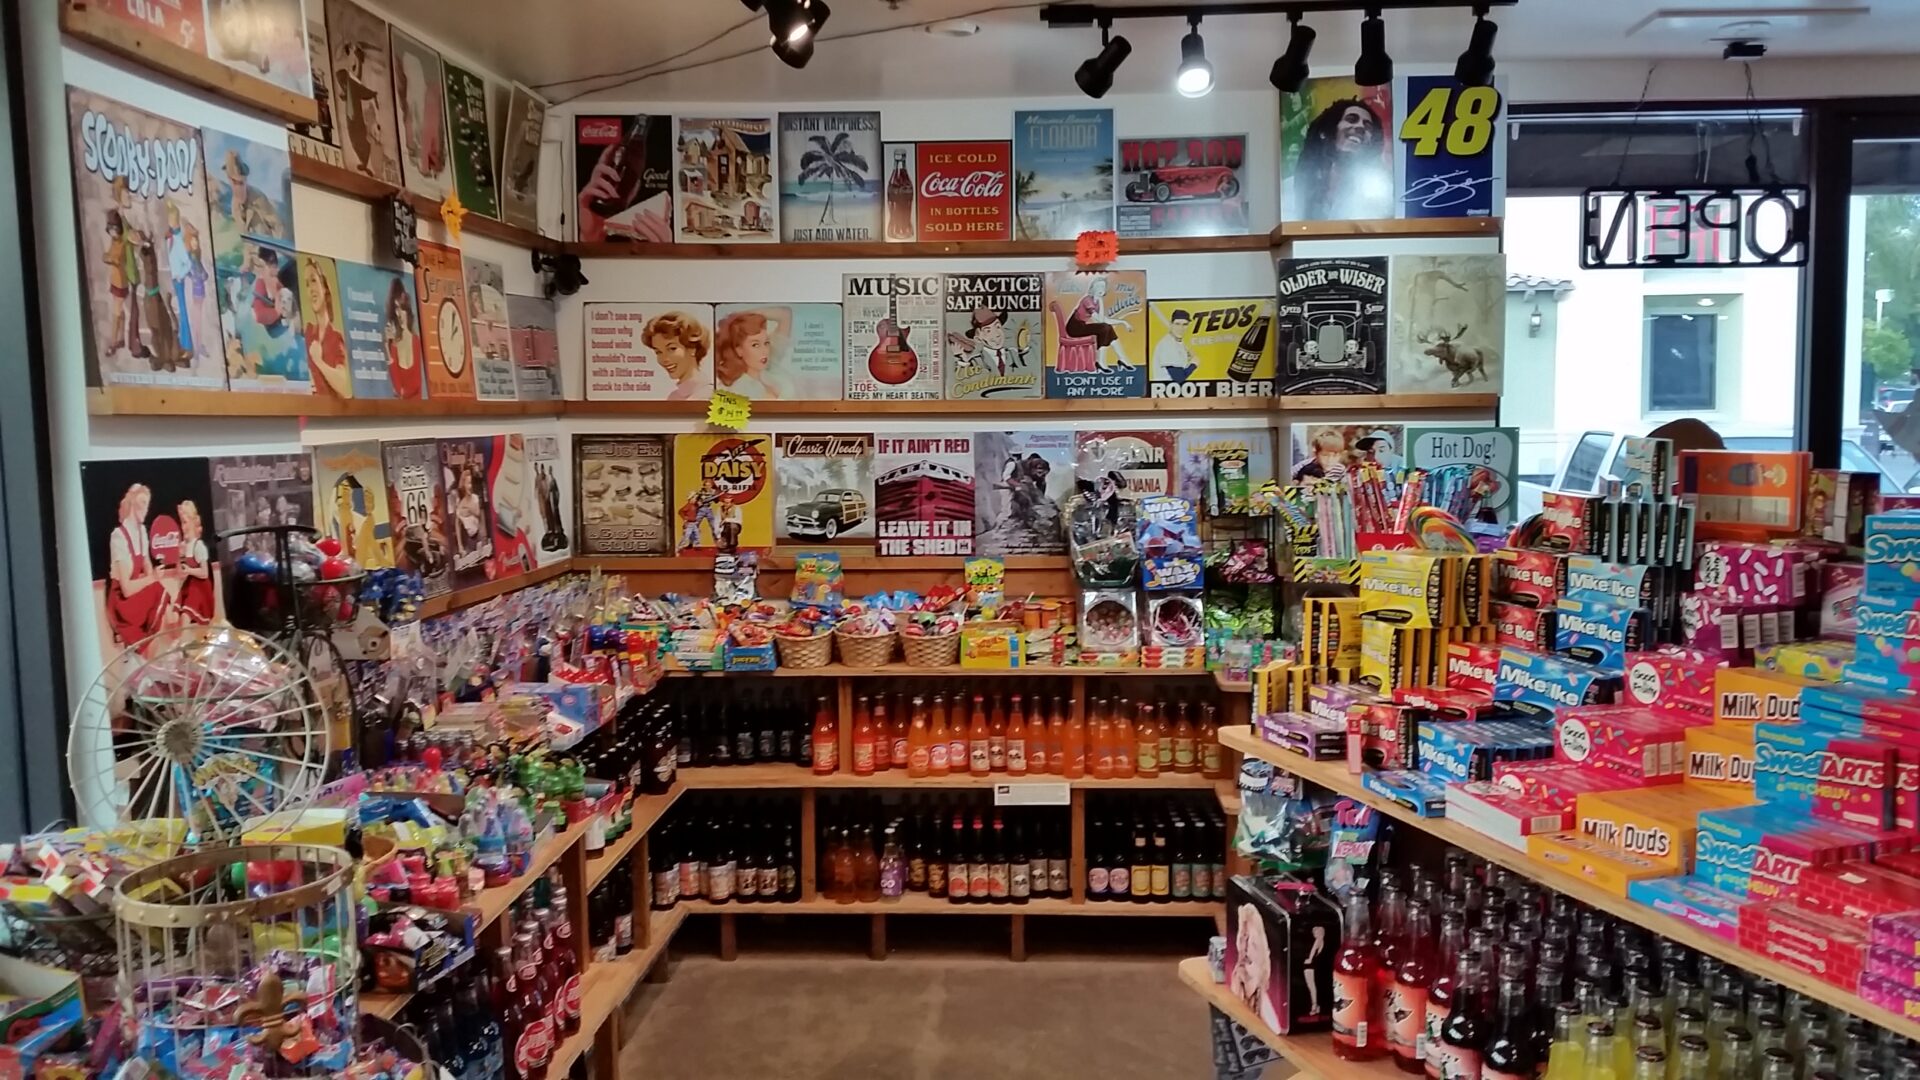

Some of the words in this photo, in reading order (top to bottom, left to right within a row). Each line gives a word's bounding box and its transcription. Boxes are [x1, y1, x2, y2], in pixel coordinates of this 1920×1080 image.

[784, 117, 821, 132] INSTANT
[1399, 86, 1499, 157] 48
[1029, 124, 1098, 149] FLORIDA
[81, 110, 197, 198] SCOOBY-DOO!
[929, 154, 953, 164] ICE
[957, 153, 997, 164] COLD
[921, 171, 1007, 198] Coca-Cola
[930, 206, 942, 216] IN
[946, 206, 1000, 216] BOTTLES
[793, 228, 814, 242] JUST
[816, 228, 834, 242] ADD
[925, 223, 962, 232] SOLD
[966, 222, 1005, 232] HERE
[848, 277, 940, 296] MUSIC
[946, 277, 1041, 293] PRACTICE
[1280, 268, 1328, 295] OLDER
[1339, 268, 1386, 295] WISER
[946, 295, 983, 311] SAFE
[987, 295, 1041, 310] LUNCH
[1192, 304, 1257, 335] TED'S
[622, 381, 635, 391] the
[854, 383, 879, 391] TOES
[952, 375, 1037, 398] Condiments
[1056, 377, 1060, 386] I
[1101, 376, 1121, 385] USE
[1124, 376, 1135, 385] IT
[1066, 387, 1087, 396] ANY
[1090, 386, 1124, 396] MORE
[1150, 383, 1210, 398] ROOT
[1216, 381, 1274, 398] BEER
[849, 392, 871, 400] KEEPS
[872, 392, 883, 400] MY
[886, 392, 909, 400] HEART
[911, 391, 940, 400] BEATING
[787, 435, 824, 457] Classic
[824, 435, 864, 459] Woody
[878, 439, 890, 454] IF
[892, 439, 905, 454] IT
[908, 439, 941, 454] AIN'T
[944, 439, 970, 454] RED
[1431, 437, 1458, 458] Hot
[1462, 436, 1496, 464] Dog!
[703, 461, 764, 478] DAISY
[402, 475, 427, 487] ROUTE
[405, 491, 428, 525] 66
[879, 521, 930, 537] LEAVE
[933, 520, 949, 537] IT
[953, 520, 972, 537] IN
[598, 541, 650, 551] CLUB
[879, 539, 910, 555] THE
[911, 539, 957, 555] SHED
[1157, 562, 1194, 575] WAX
[1363, 577, 1398, 594] Mike
[1400, 583, 1423, 597] Ike
[1532, 571, 1553, 588] Ike
[1570, 572, 1609, 591] Mike
[1611, 580, 1637, 599] Ike
[1499, 620, 1513, 635] ke
[1515, 623, 1535, 642] Ike
[1558, 613, 1596, 634] Mike
[1598, 620, 1623, 643] Ike
[1450, 657, 1481, 677] Mike
[1484, 666, 1497, 685] Ik
[1501, 664, 1547, 696] Mike
[1550, 681, 1579, 706] Ike
[1721, 692, 1761, 719] Milk
[1764, 694, 1801, 720] Dud
[1360, 719, 1378, 735] ike
[1379, 725, 1396, 741] Ike
[1418, 740, 1445, 764] Mike
[1446, 754, 1466, 777] Ike
[1689, 752, 1727, 780] Milk
[1728, 757, 1755, 783] Du
[1755, 742, 1886, 789] SweeTARTS
[1582, 818, 1621, 850] Milk
[1622, 824, 1670, 857] Duds
[1696, 831, 1811, 885] SweeTART
